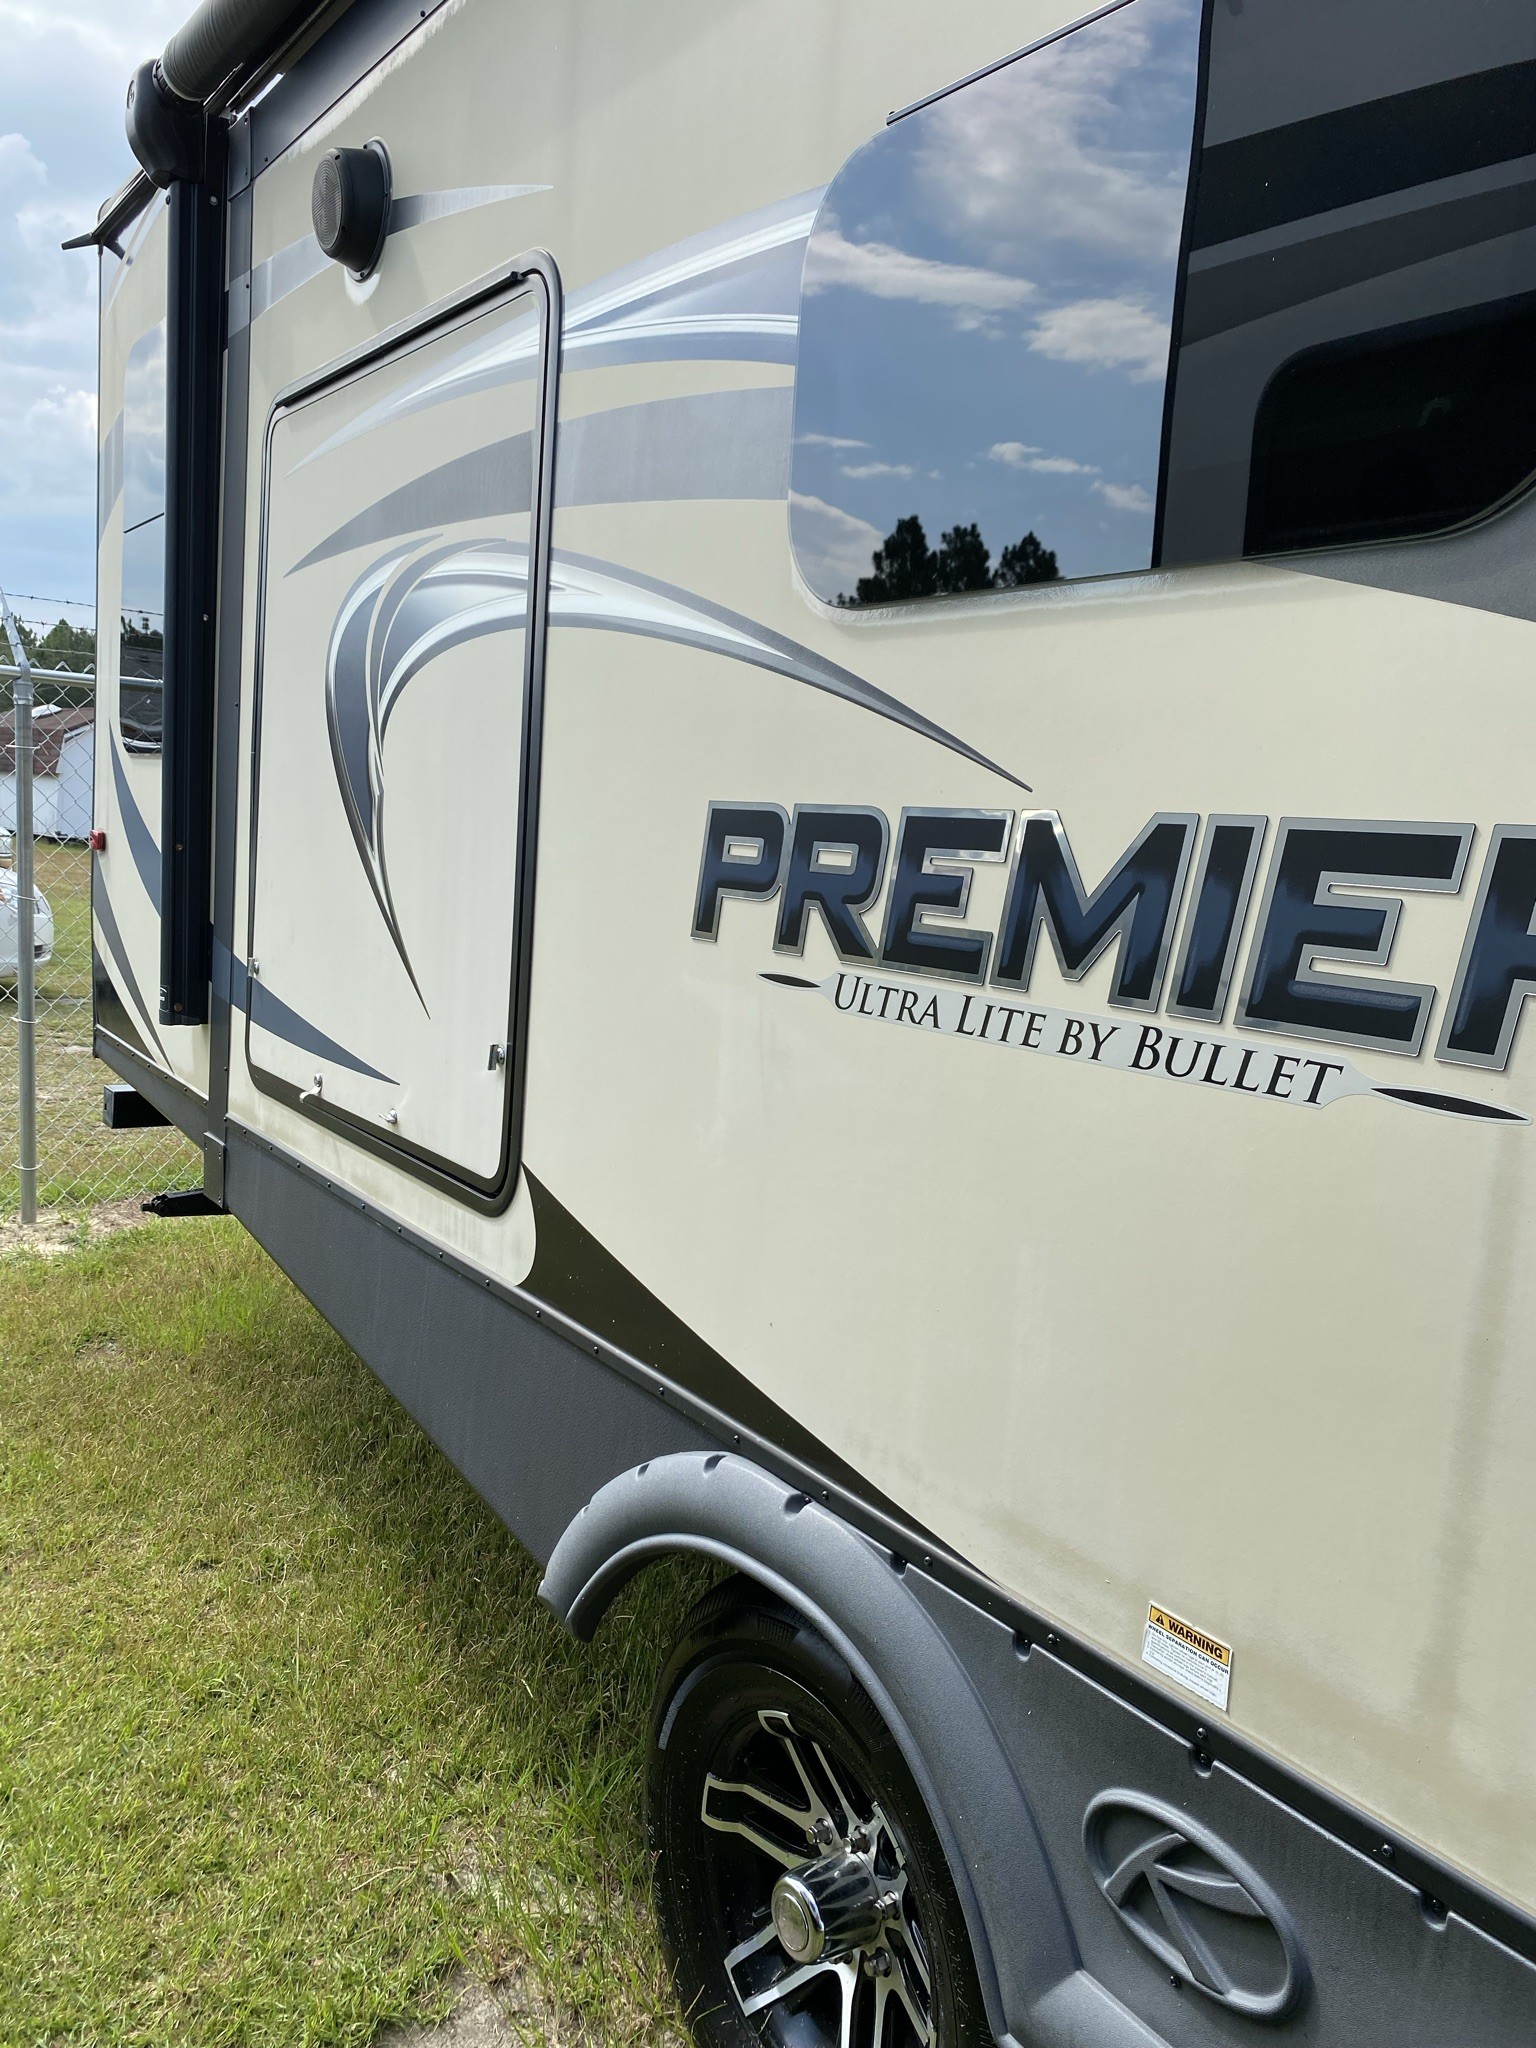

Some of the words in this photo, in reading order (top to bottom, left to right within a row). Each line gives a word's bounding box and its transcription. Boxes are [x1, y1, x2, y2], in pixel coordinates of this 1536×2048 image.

[834, 973, 941, 1029] ULTRA
[954, 994, 1047, 1048] LITE
[1056, 1018, 1119, 1061] BY
[1128, 1024, 1344, 1105] BULLET
[1148, 1624, 1164, 1637] WHEEL
[1166, 1634, 1198, 1657] SEPARATION
[1198, 1653, 1210, 1663] CAN
[1210, 1660, 1229, 1675] OCCUR
[1168, 1619, 1223, 1660] WARNING
